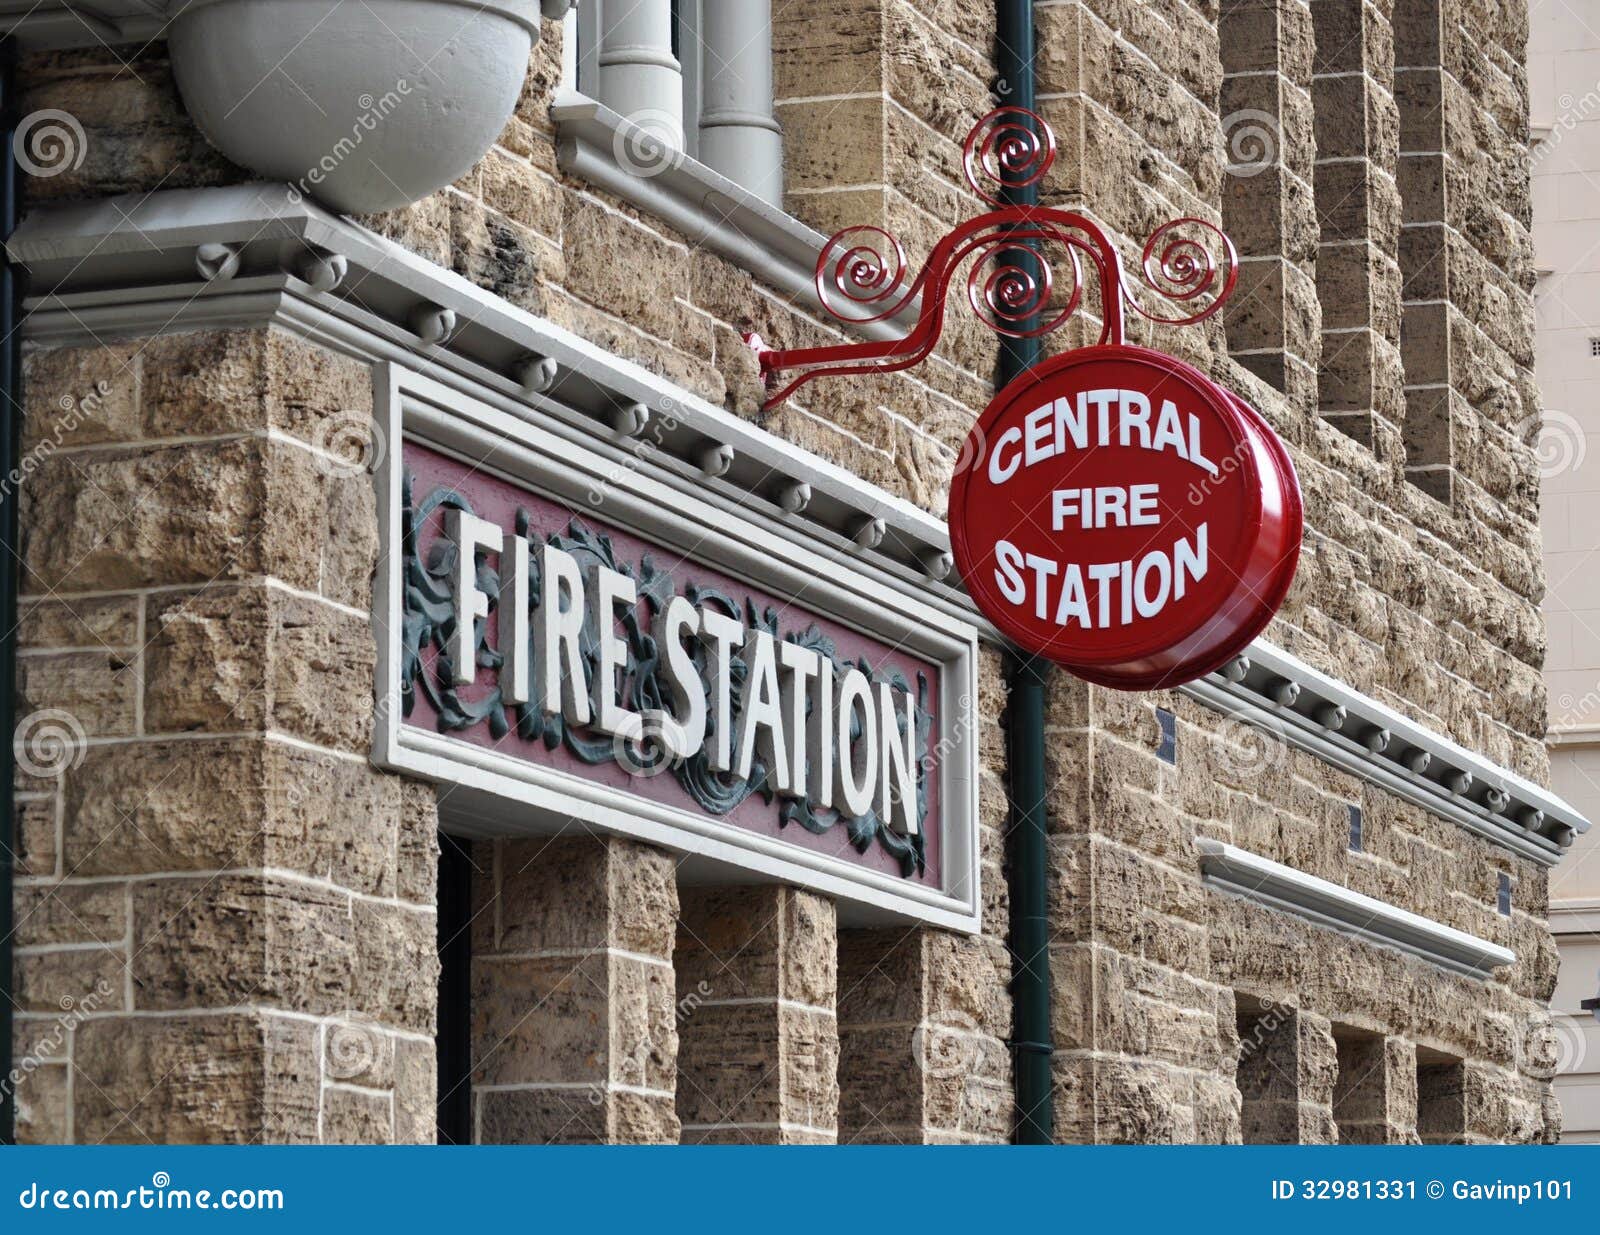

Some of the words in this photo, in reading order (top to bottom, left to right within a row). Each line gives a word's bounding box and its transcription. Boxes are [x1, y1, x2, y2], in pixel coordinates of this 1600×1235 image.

[988, 388, 1219, 485] CENTRAL
[1052, 484, 1161, 531] FIRE
[994, 521, 1208, 629] STATION
[445, 508, 644, 741] FIRE
[656, 595, 918, 835] STATION
